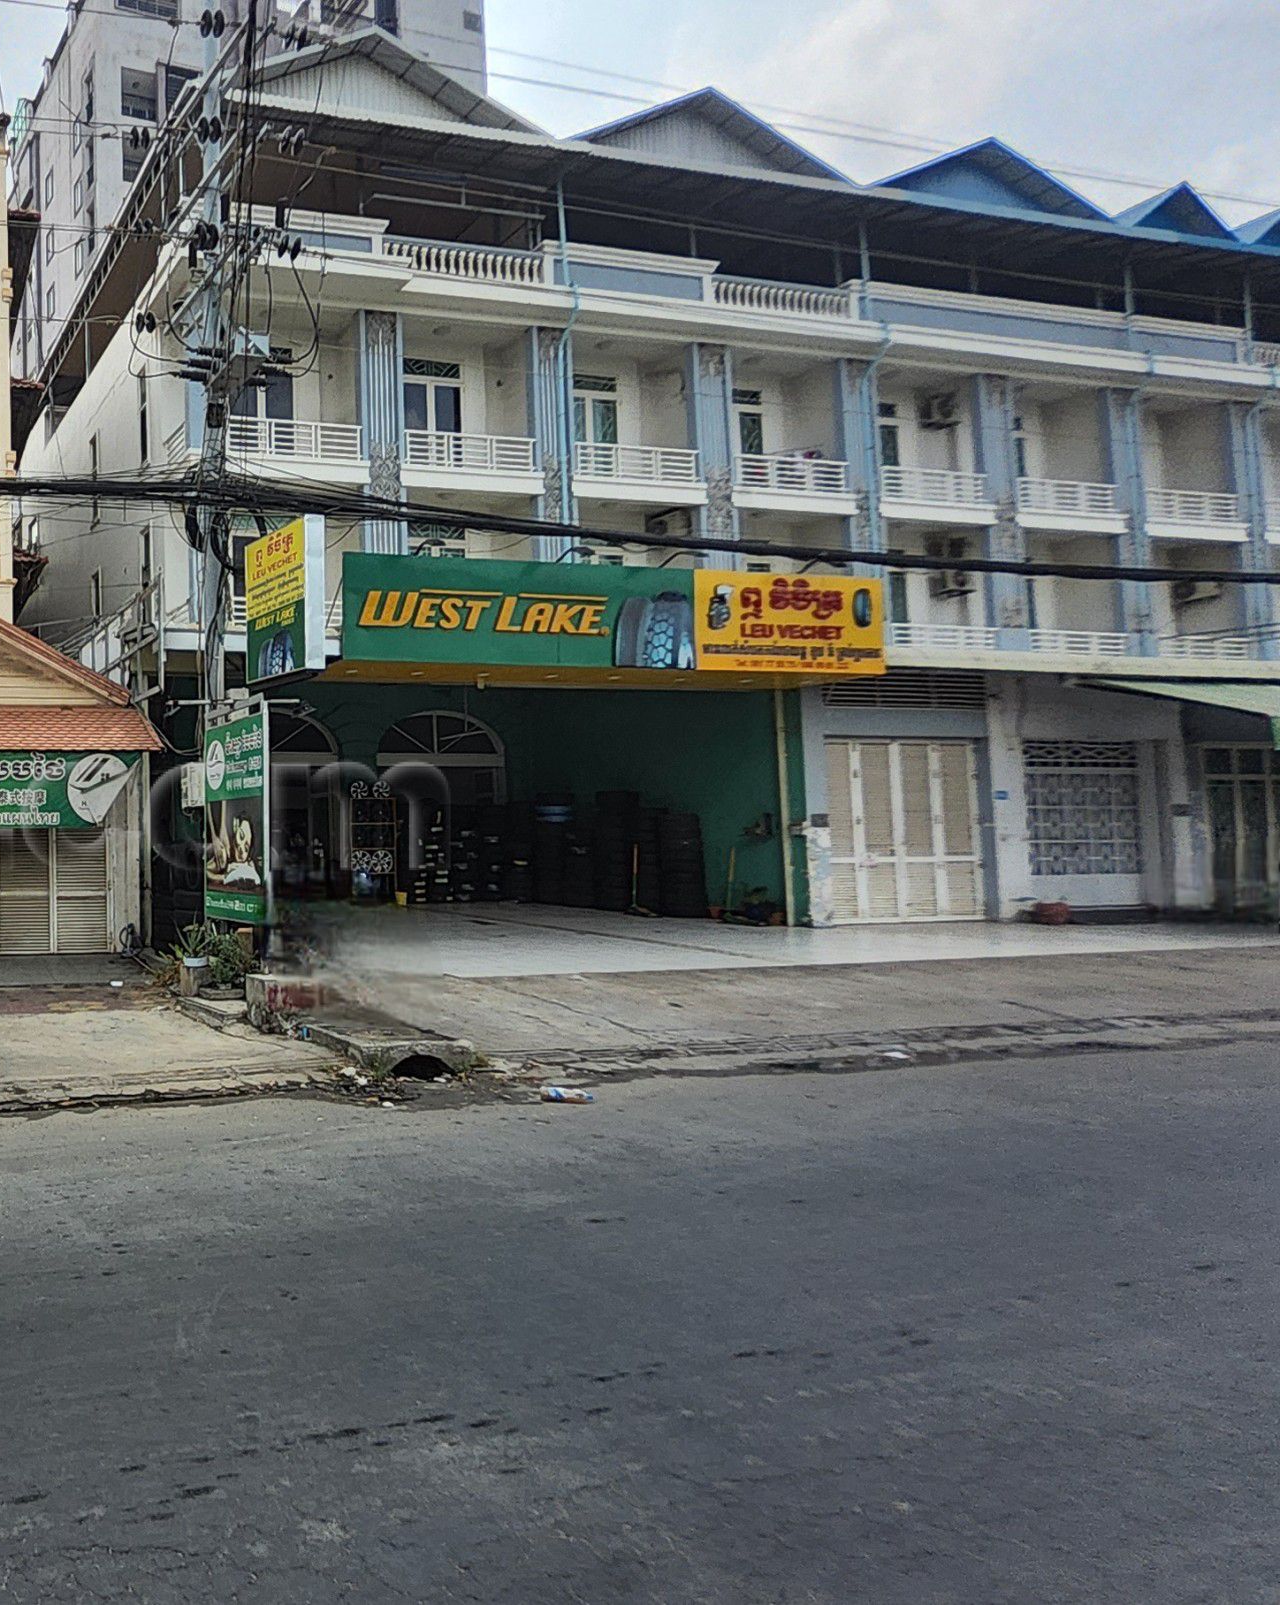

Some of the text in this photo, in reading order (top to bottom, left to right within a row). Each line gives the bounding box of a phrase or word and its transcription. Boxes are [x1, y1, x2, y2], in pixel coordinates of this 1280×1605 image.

[252, 569, 266, 581] LEU
[358, 589, 608, 635] WEST LAKE
[739, 623, 845, 641] LEU VECHET
